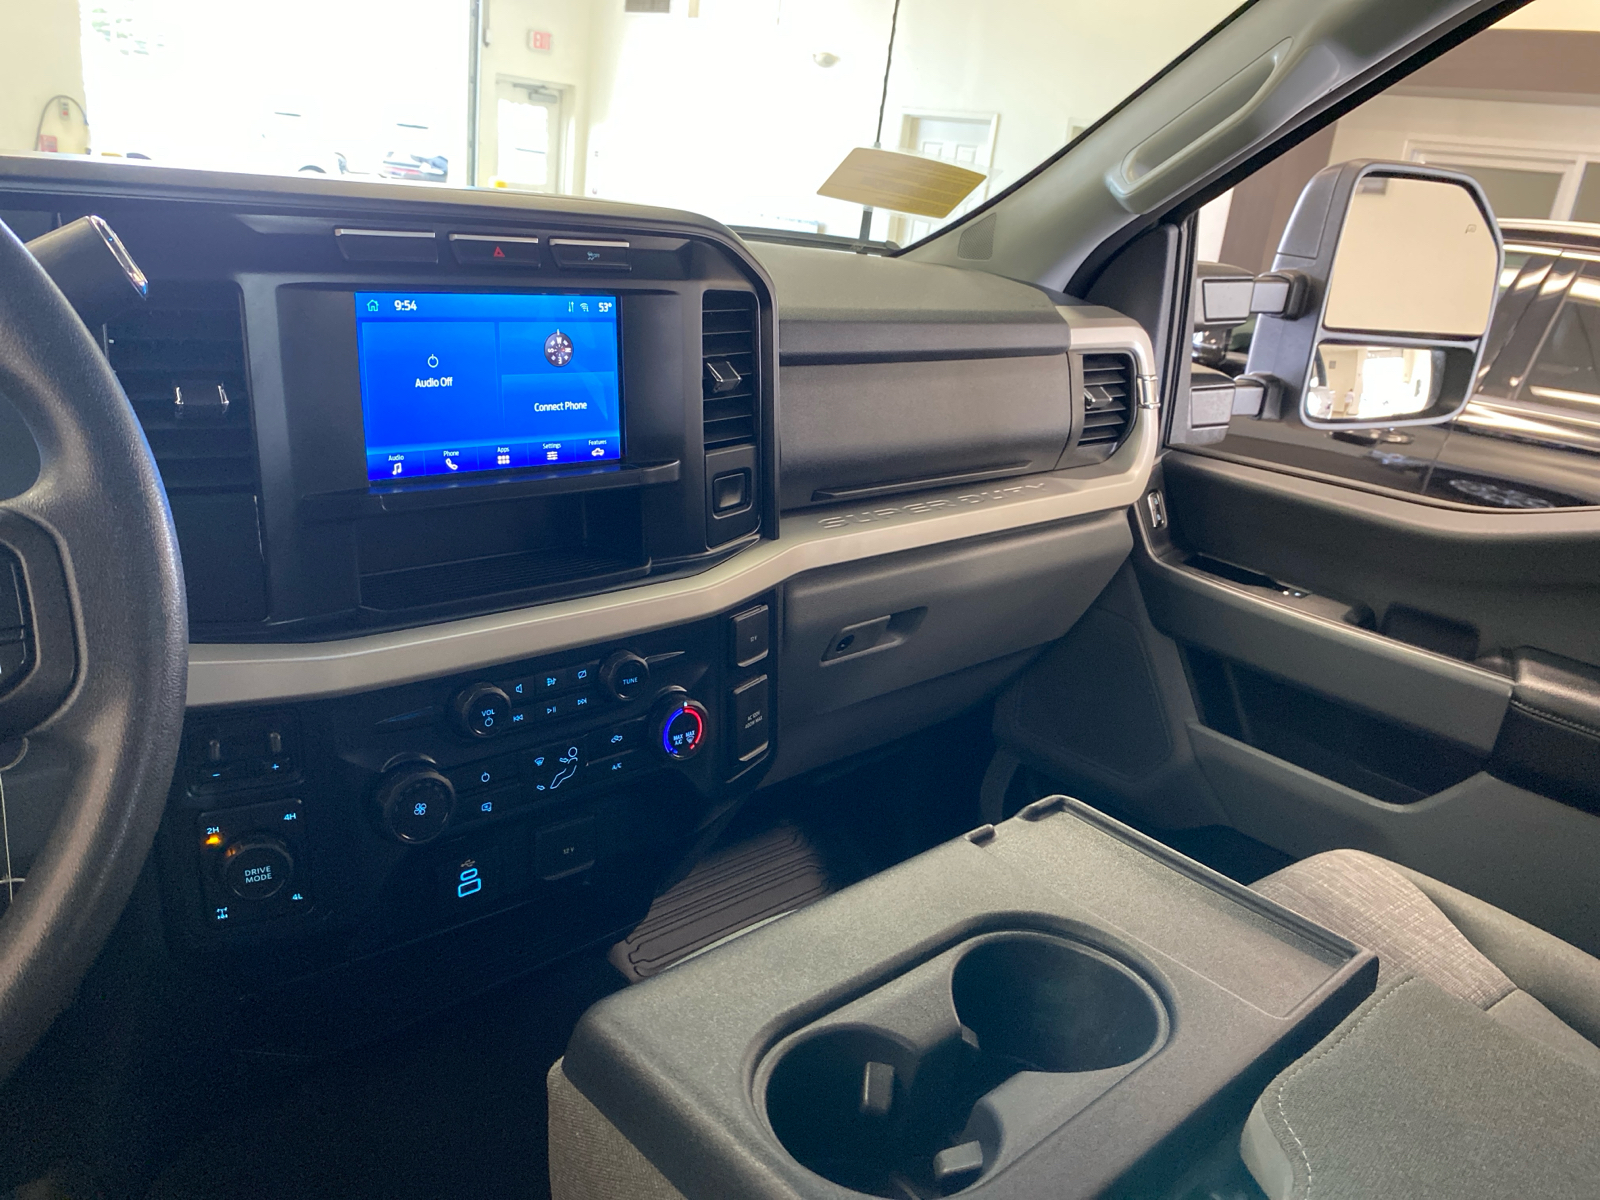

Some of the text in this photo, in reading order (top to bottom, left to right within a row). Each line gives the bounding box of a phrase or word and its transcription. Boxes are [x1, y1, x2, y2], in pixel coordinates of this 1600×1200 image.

[394, 300, 417, 311] 9:54
[415, 377, 453, 388] Audio Off
[534, 400, 588, 413] Connect Phone
[542, 441, 562, 451] Settings
[588, 438, 608, 447] Features
[443, 449, 460, 458] Phone
[497, 446, 510, 455] Apps
[388, 454, 405, 462] Audio
[818, 482, 1046, 530] SUPER DUTY
[622, 677, 638, 685] TUNE
[481, 709, 495, 717] VOL
[611, 762, 622, 770] A/C
[283, 812, 296, 820] 4H
[206, 826, 219, 834] 2H
[244, 866, 271, 877] DRIVE
[245, 873, 272, 883] MODE
